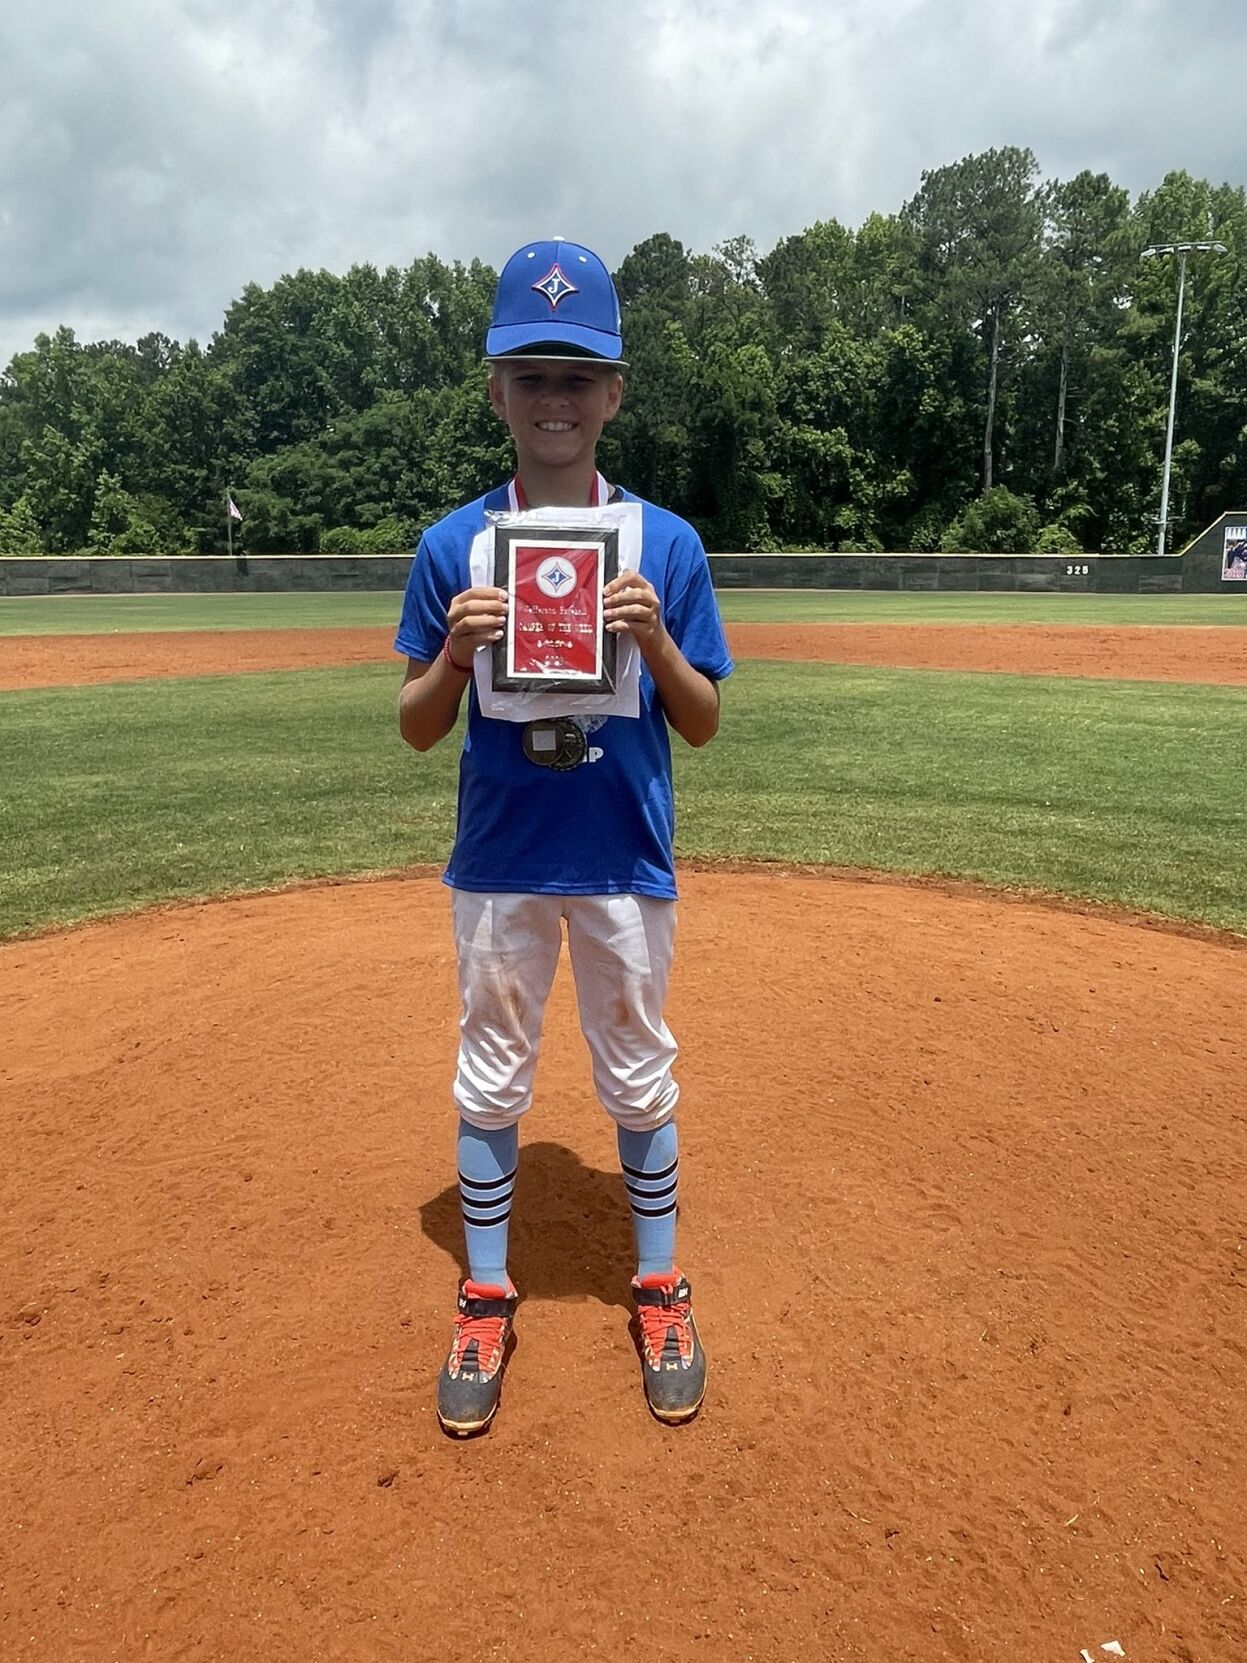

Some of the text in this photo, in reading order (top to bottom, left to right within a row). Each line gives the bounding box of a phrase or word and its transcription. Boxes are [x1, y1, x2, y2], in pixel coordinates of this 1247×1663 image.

[547, 278, 561, 294] J
[1066, 565, 1089, 575] 325
[551, 571, 560, 583] J
